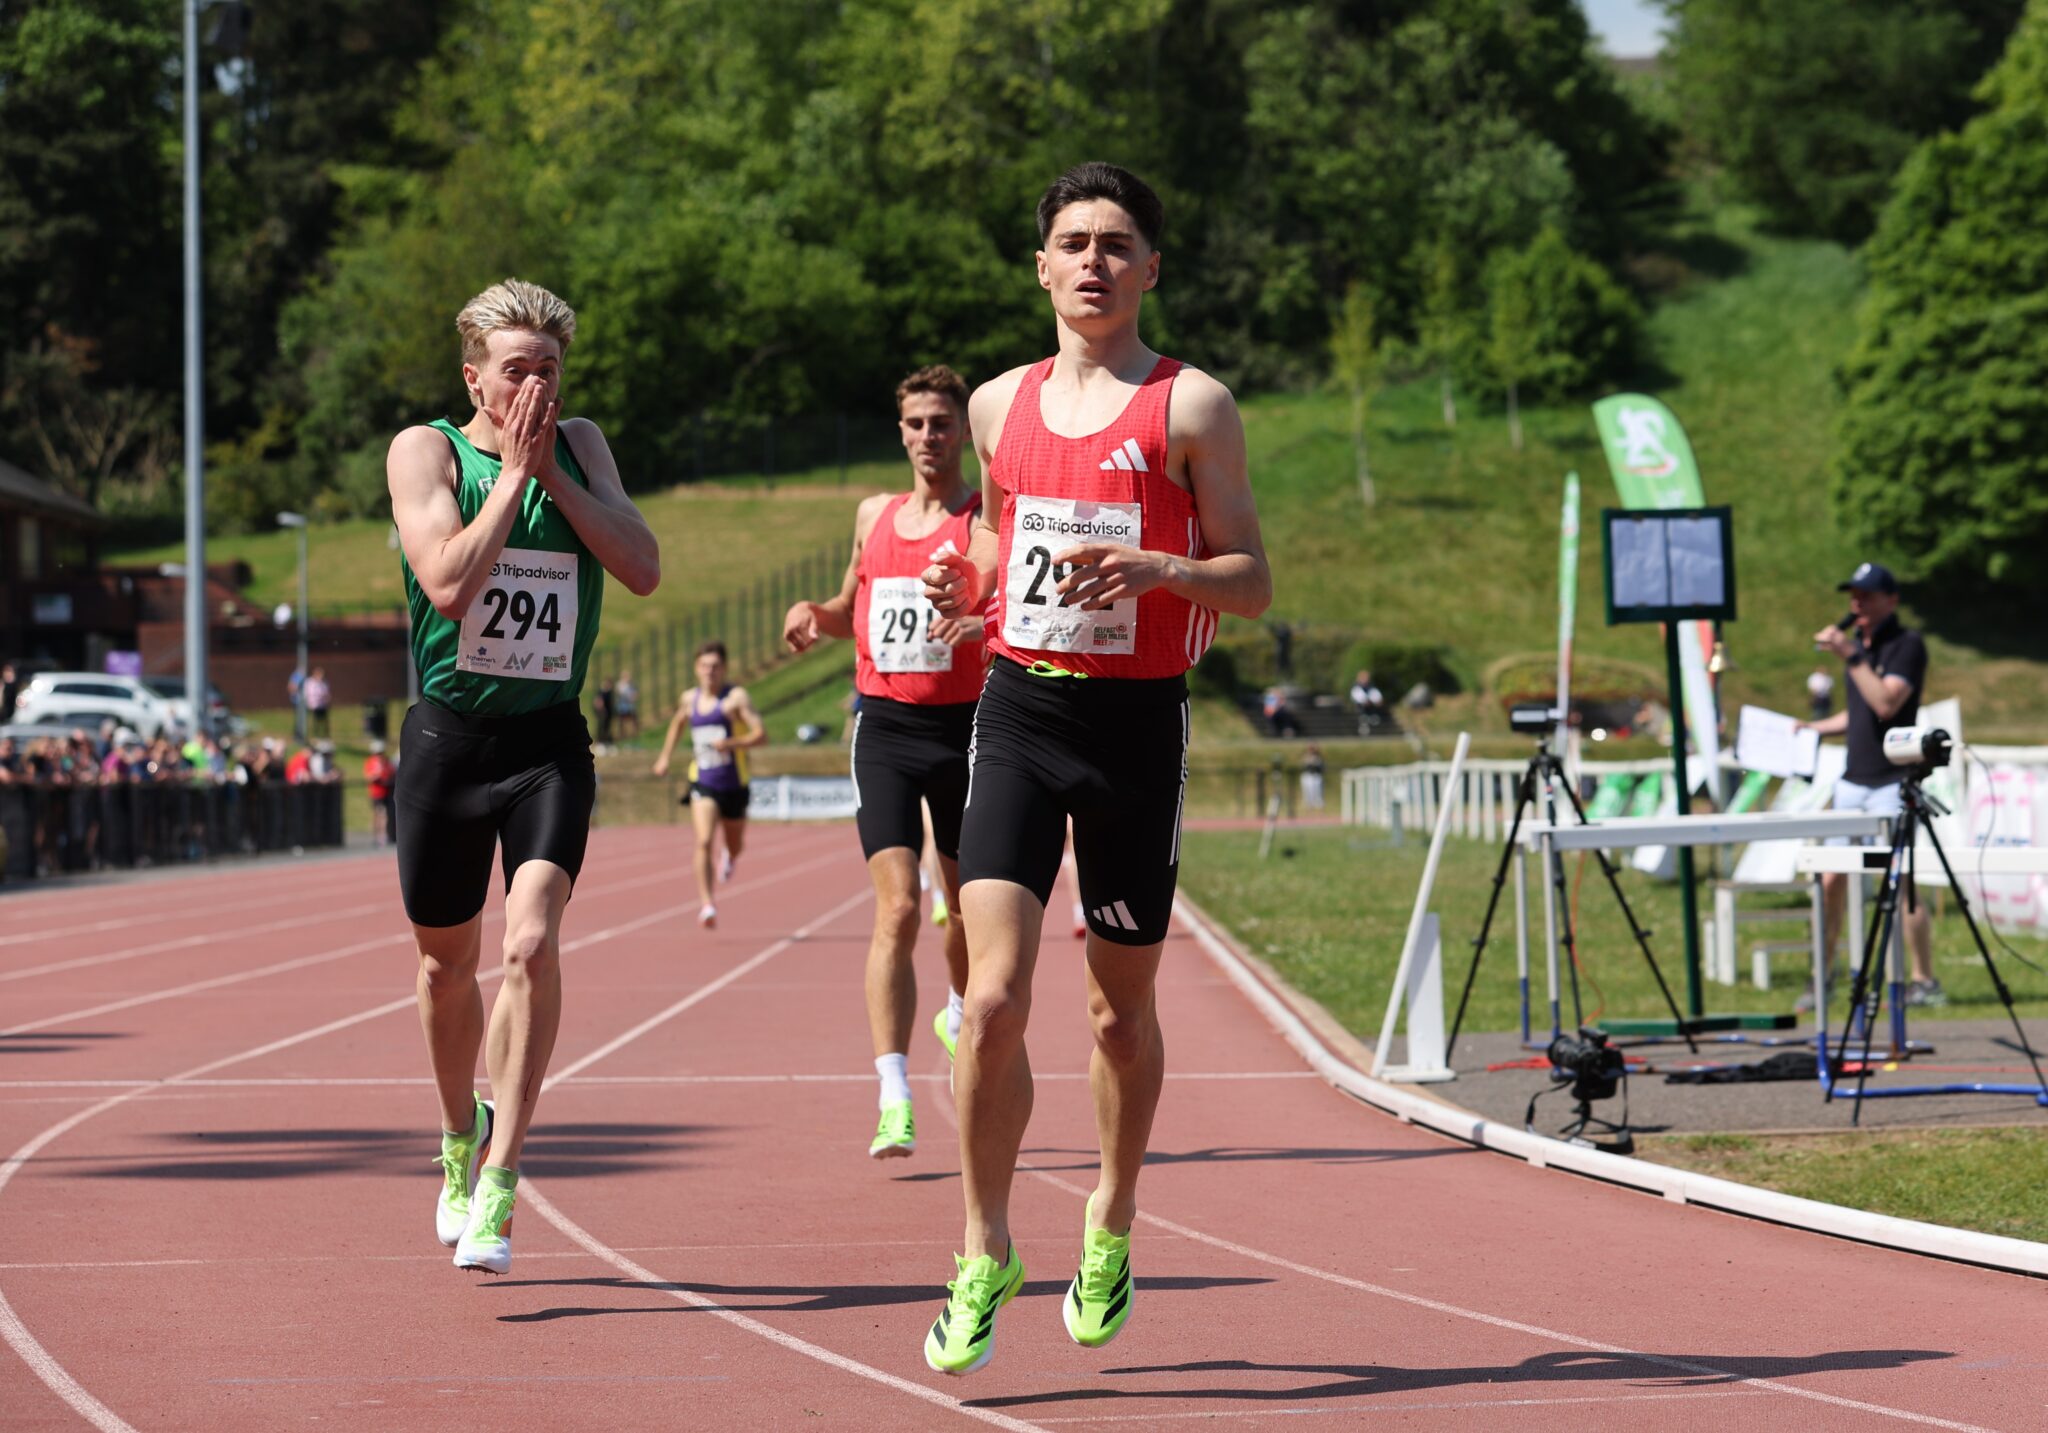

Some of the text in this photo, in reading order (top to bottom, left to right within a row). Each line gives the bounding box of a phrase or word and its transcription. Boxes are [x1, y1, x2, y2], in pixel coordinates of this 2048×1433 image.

[1047, 516, 1131, 536] Tripadvisor
[502, 563, 571, 581] Tripadvisor
[1023, 545, 1114, 611] 29
[480, 587, 562, 643] 294
[1094, 626, 1116, 634] BELFAST
